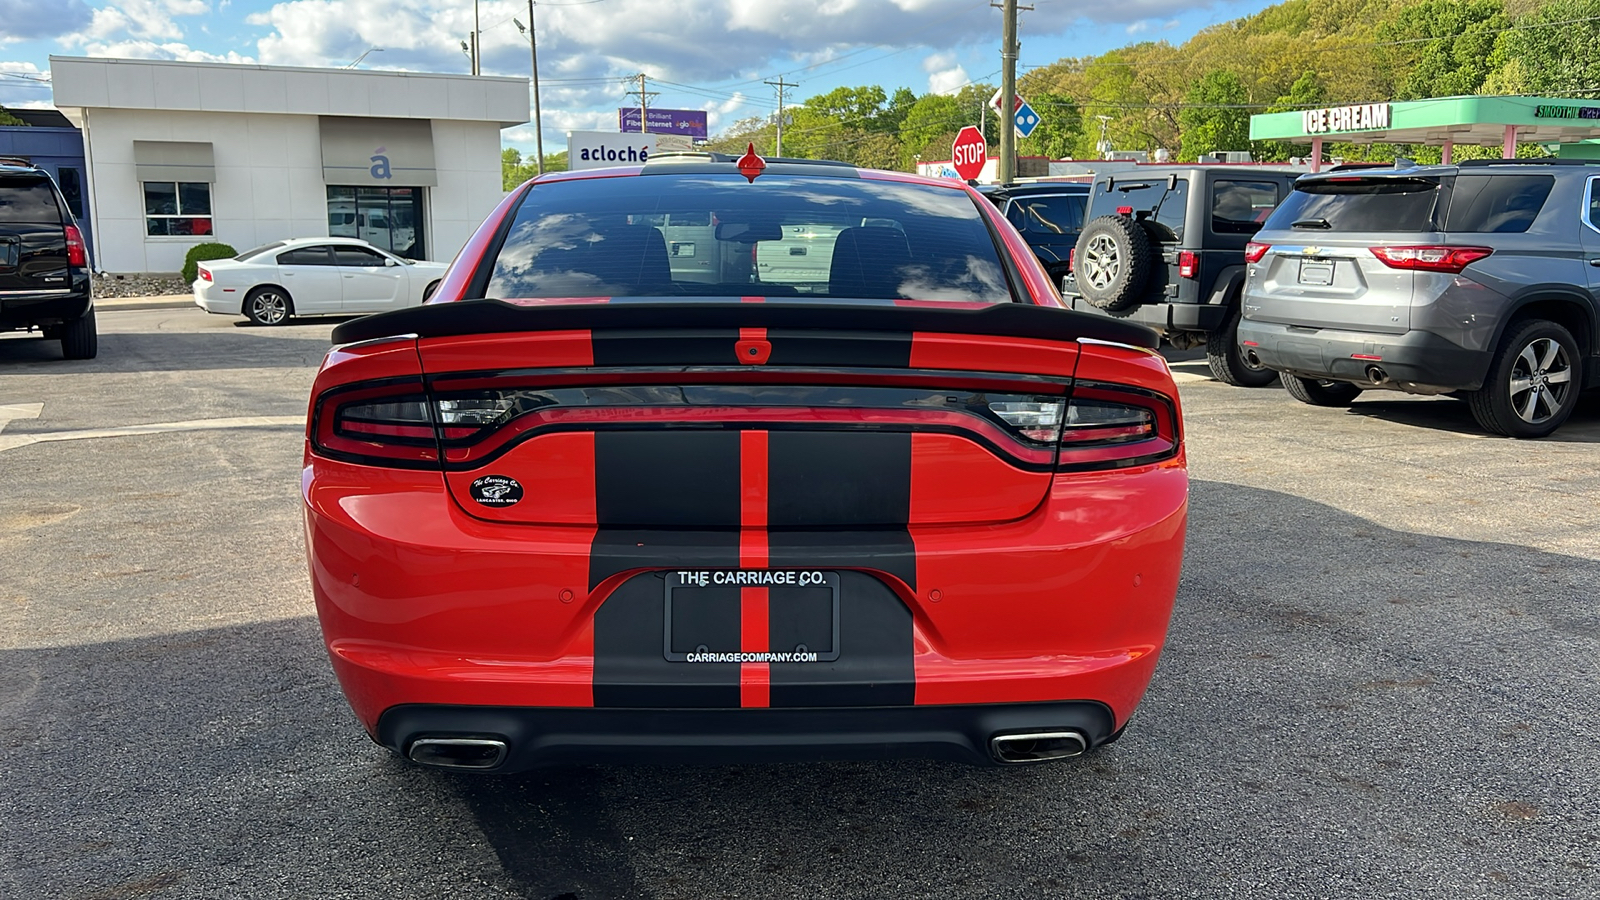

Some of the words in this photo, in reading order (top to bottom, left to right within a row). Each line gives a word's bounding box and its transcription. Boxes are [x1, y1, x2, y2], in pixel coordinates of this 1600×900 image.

[646, 120, 672, 128] Internet
[1302, 108, 1328, 133] ICE
[1330, 103, 1390, 131] CREAM
[580, 144, 649, 162] acloché
[954, 142, 985, 167] STOP
[473, 478, 483, 487] The
[483, 476, 508, 485] Carriage
[677, 571, 709, 585] THE
[713, 571, 796, 584] CARRIAGE
[799, 571, 827, 585] CO.
[686, 652, 818, 663] CARRIAGECOMPANY.COM
